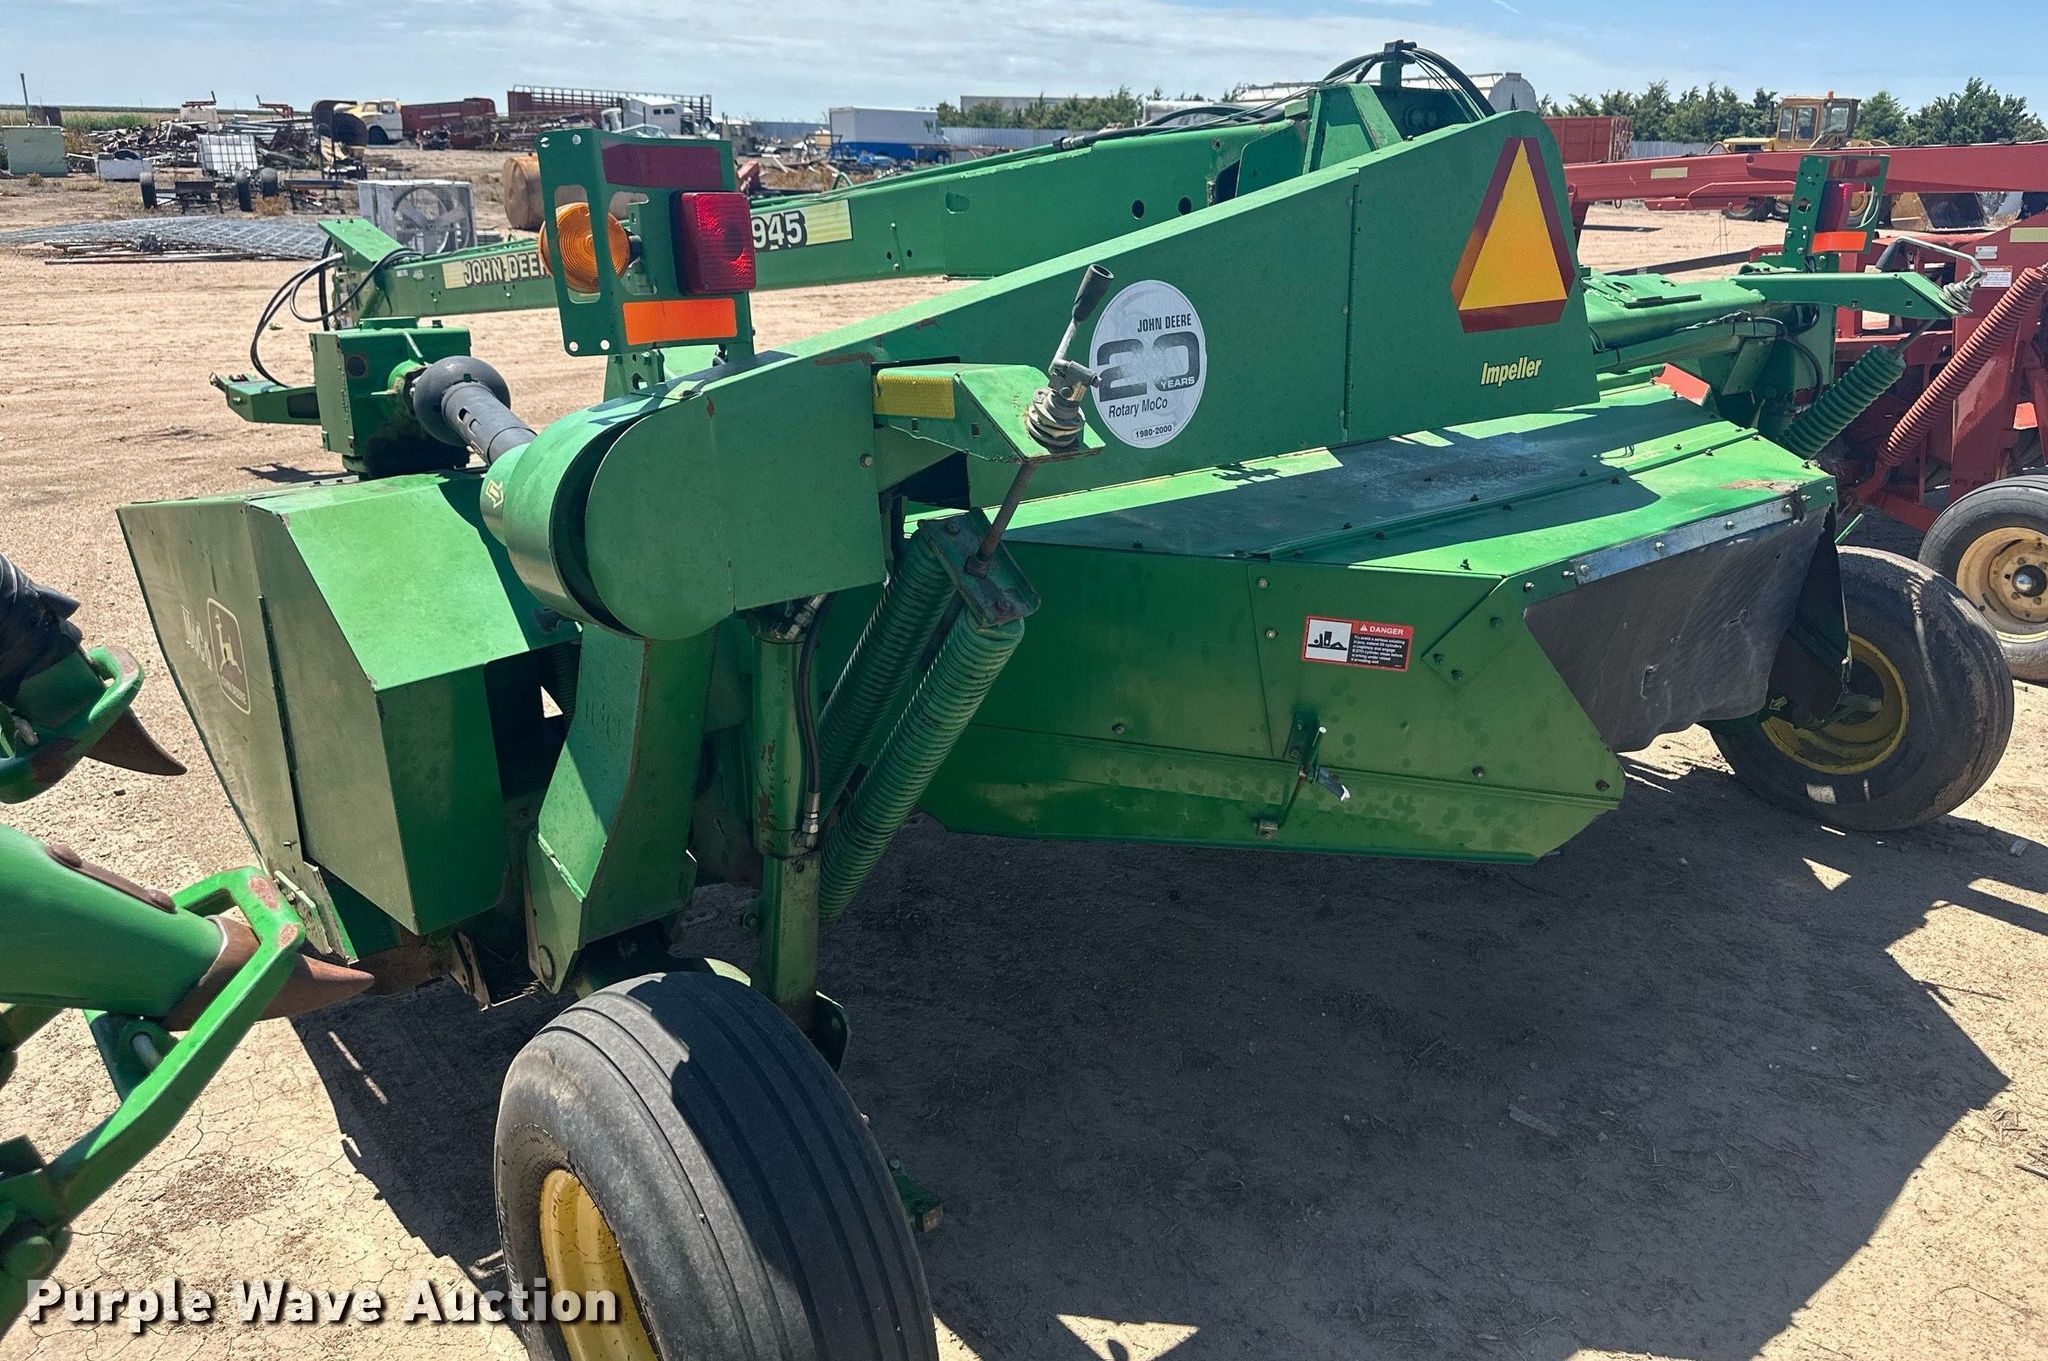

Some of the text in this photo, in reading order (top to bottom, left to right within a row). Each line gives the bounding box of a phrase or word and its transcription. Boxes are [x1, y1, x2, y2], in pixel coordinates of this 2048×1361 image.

[751, 211, 803, 249] 945
[464, 251, 546, 285] JOHN DEE
[1137, 313, 1192, 333] JOHN DEERE
[1097, 331, 1200, 403] 20
[1480, 356, 1542, 387] Impeller
[1160, 376, 1195, 390] YEARS
[1108, 397, 1168, 419] Rotary MoCo
[1135, 424, 1173, 439] 1980-2000
[1369, 626, 1404, 635] DANGER
